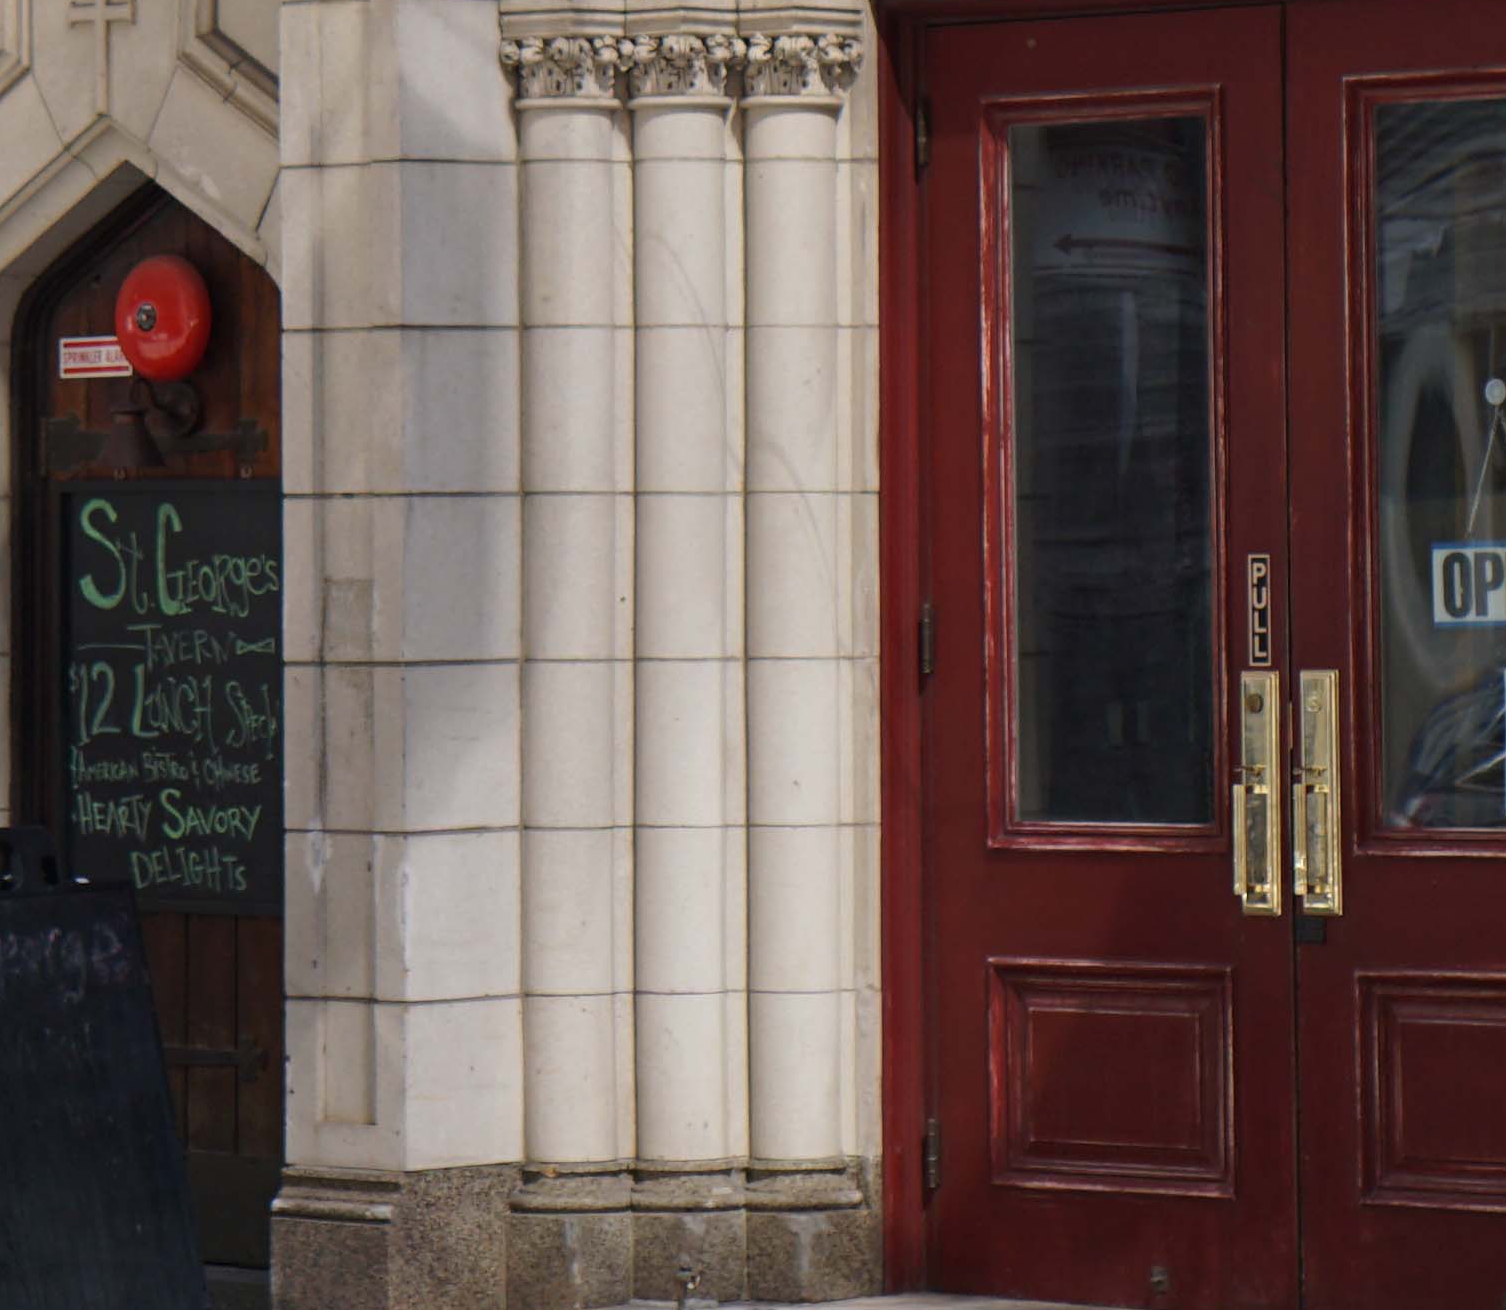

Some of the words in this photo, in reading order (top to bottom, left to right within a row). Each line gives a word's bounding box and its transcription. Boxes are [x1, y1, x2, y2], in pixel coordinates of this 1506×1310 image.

[1253, 562, 1267, 658] PULL
[77, 792, 152, 840] HEARTY
[160, 788, 262, 840] SAVORY
